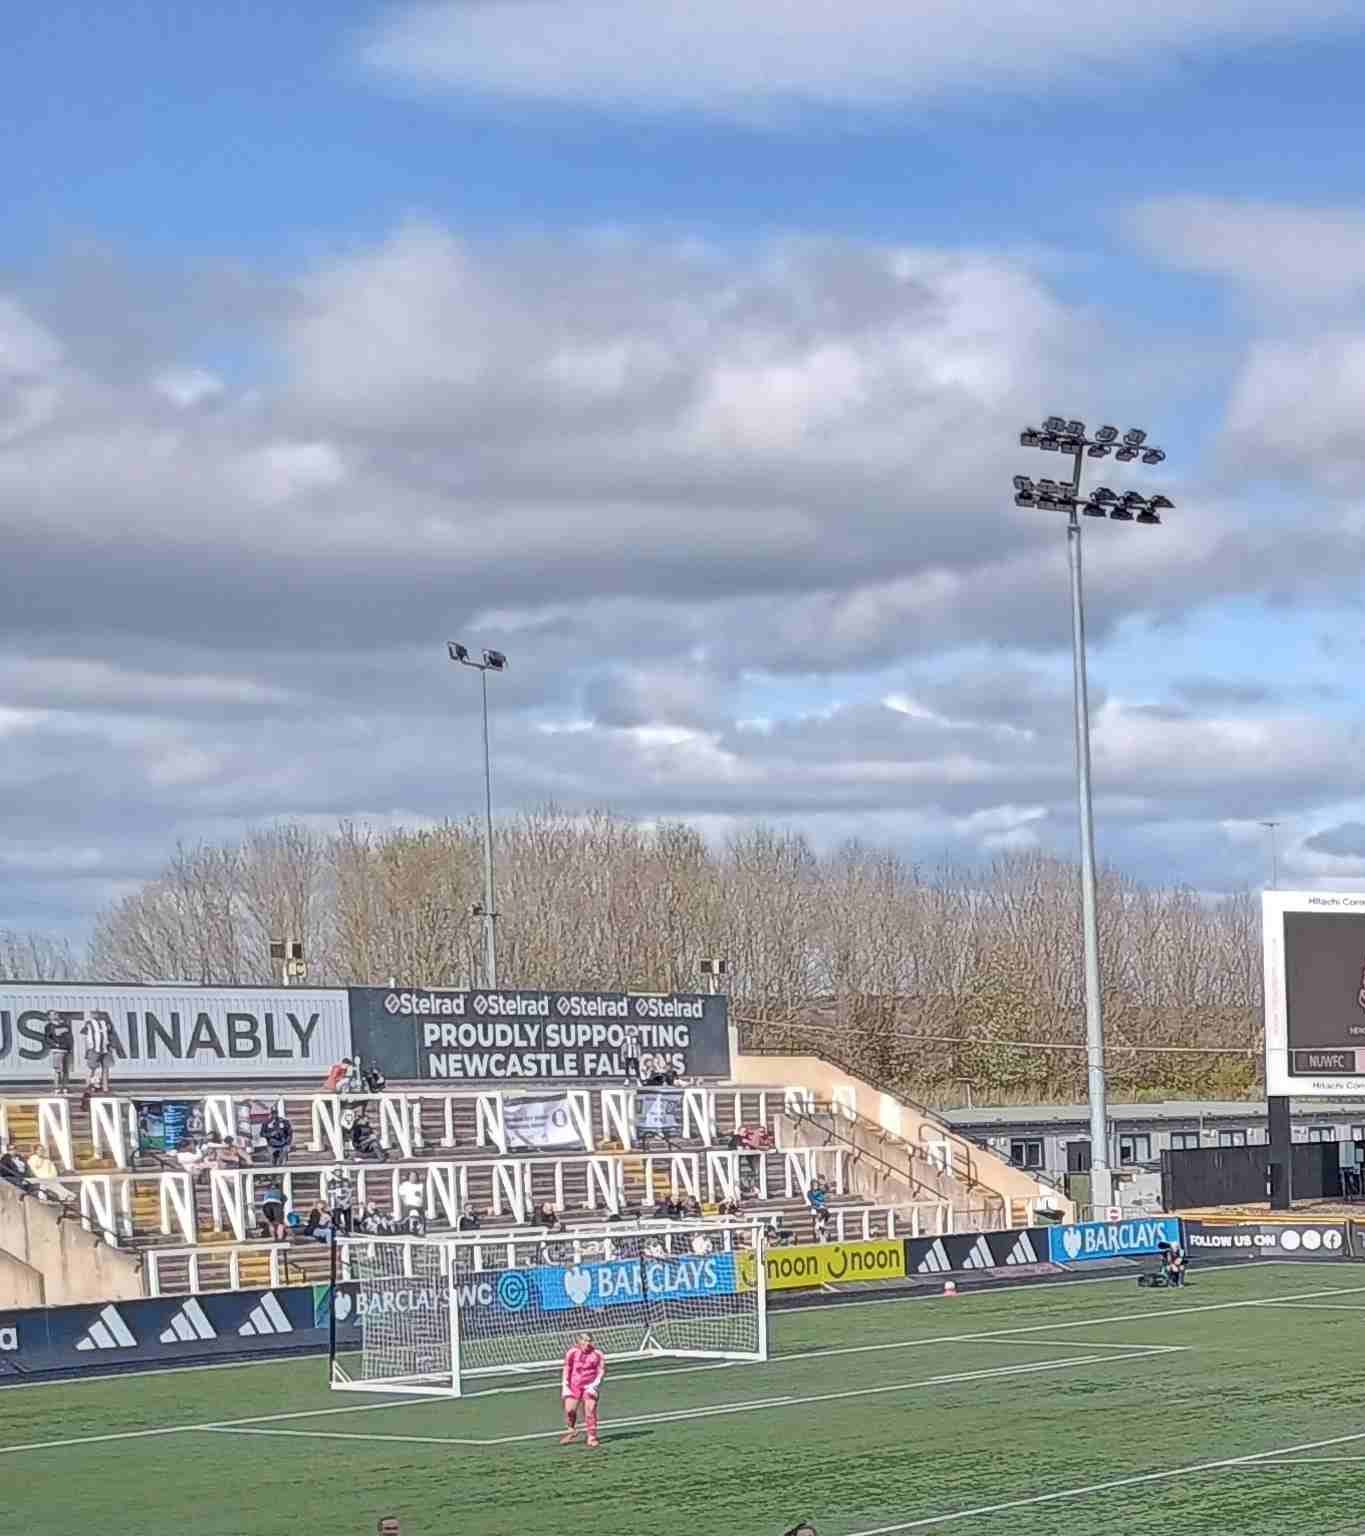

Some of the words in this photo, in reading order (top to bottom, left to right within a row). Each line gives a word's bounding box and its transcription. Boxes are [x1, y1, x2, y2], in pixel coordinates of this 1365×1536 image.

[400, 994, 465, 1015] Stelrad
[487, 995, 549, 1016] Stelrad
[570, 996, 628, 1017] Stelrad
[649, 998, 704, 1018] Stelrad
[424, 1022, 541, 1047] PROUDLY
[428, 1053, 578, 1077] NEWCASTLE
[1309, 1055, 1345, 1068] NUWFC
[1085, 1222, 1167, 1253] BARCLAYS
[1190, 1234, 1232, 1248] FOLLOW
[1234, 1234, 1252, 1248] US
[1253, 1234, 1276, 1248] ON
[767, 1253, 819, 1279] noon
[851, 1246, 901, 1271] noon
[599, 1257, 718, 1297] BARCLAYS
